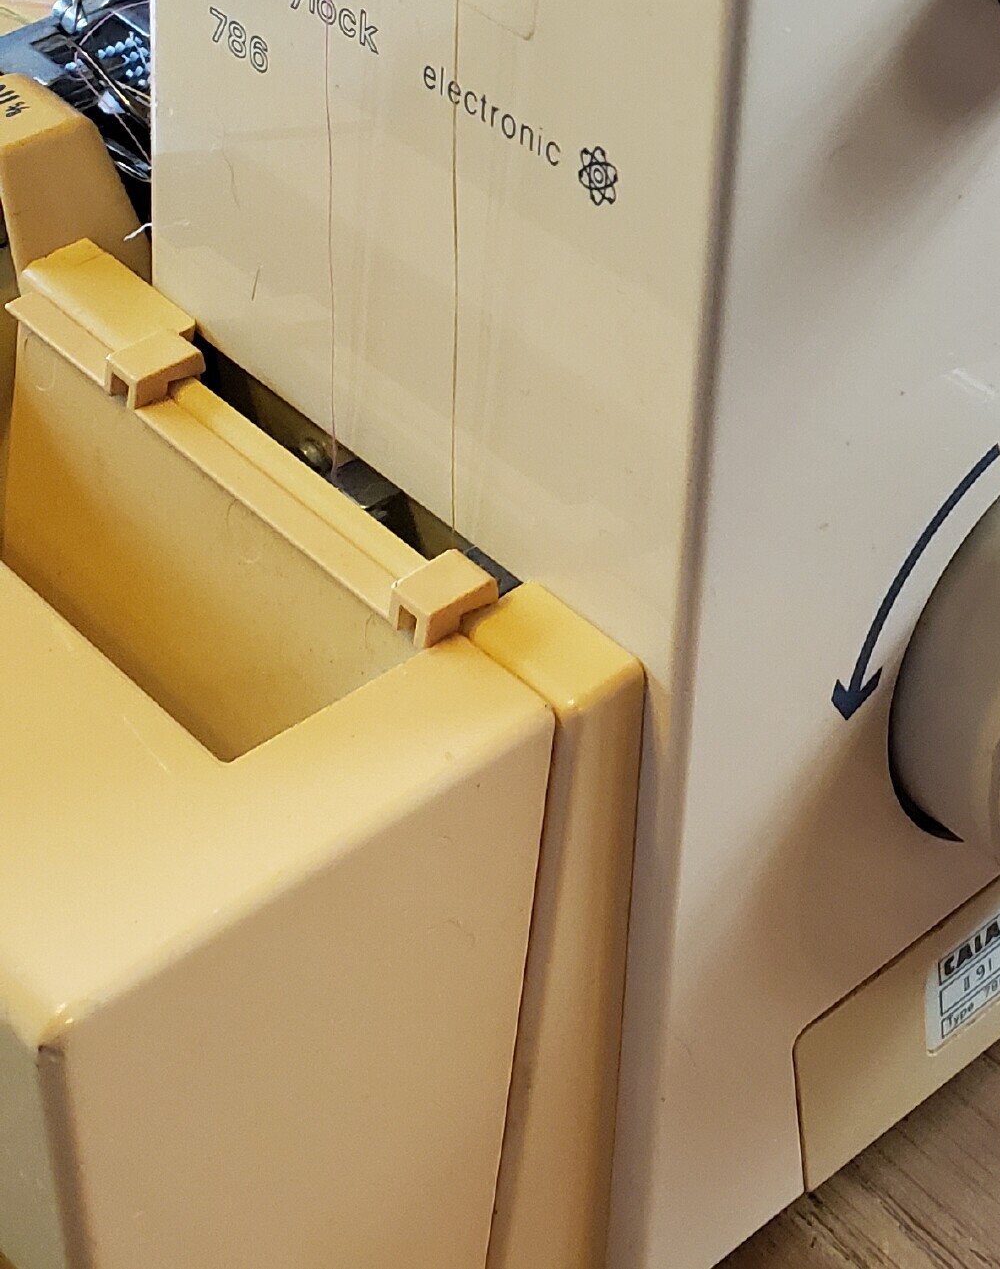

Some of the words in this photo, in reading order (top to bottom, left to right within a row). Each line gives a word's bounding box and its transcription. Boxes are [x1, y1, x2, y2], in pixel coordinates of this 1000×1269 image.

[209, 7, 268, 73] 786
[423, 65, 561, 166] electronic
[948, 1002, 975, 1027] Type
